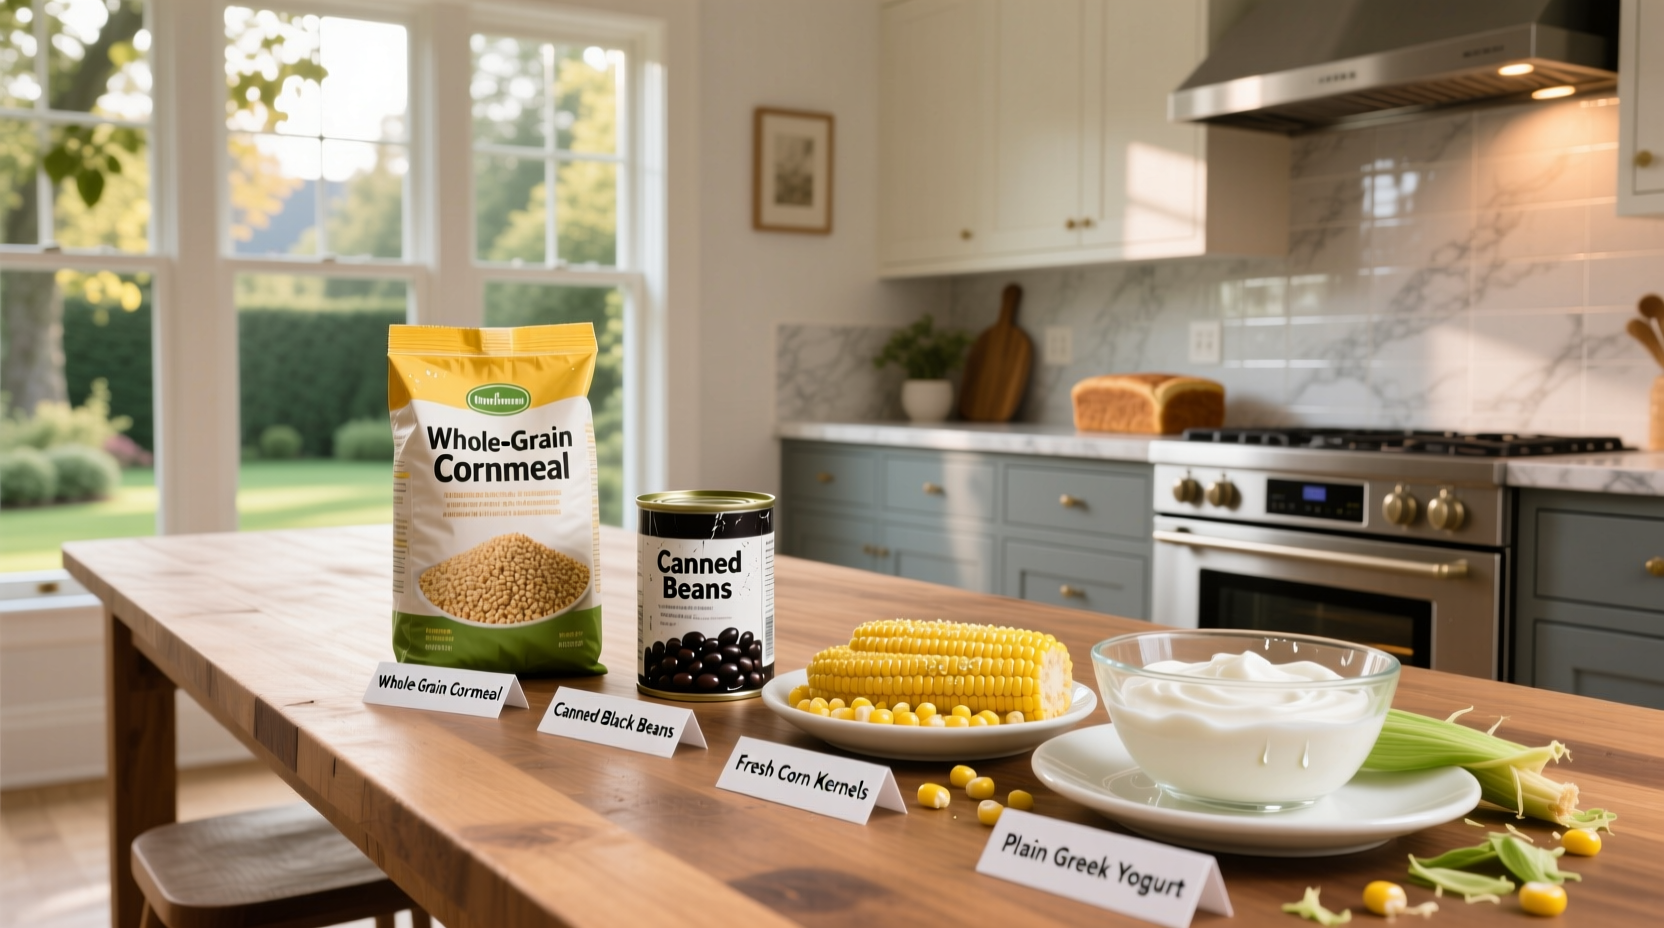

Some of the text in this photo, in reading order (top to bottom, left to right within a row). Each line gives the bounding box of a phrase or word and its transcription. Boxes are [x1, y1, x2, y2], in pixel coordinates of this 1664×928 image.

[427, 426, 573, 452] Whole-Grain
[434, 451, 570, 483] Cornmeal
[657, 549, 742, 574] Canned
[663, 576, 732, 600] Beans
[379, 674, 416, 691] Whole
[417, 678, 447, 695] Grain
[553, 701, 675, 739] Canned Black Beans
[735, 754, 869, 801] Fresh Corn Kernels
[1001, 832, 1186, 898] Plain Greek Yogurt
